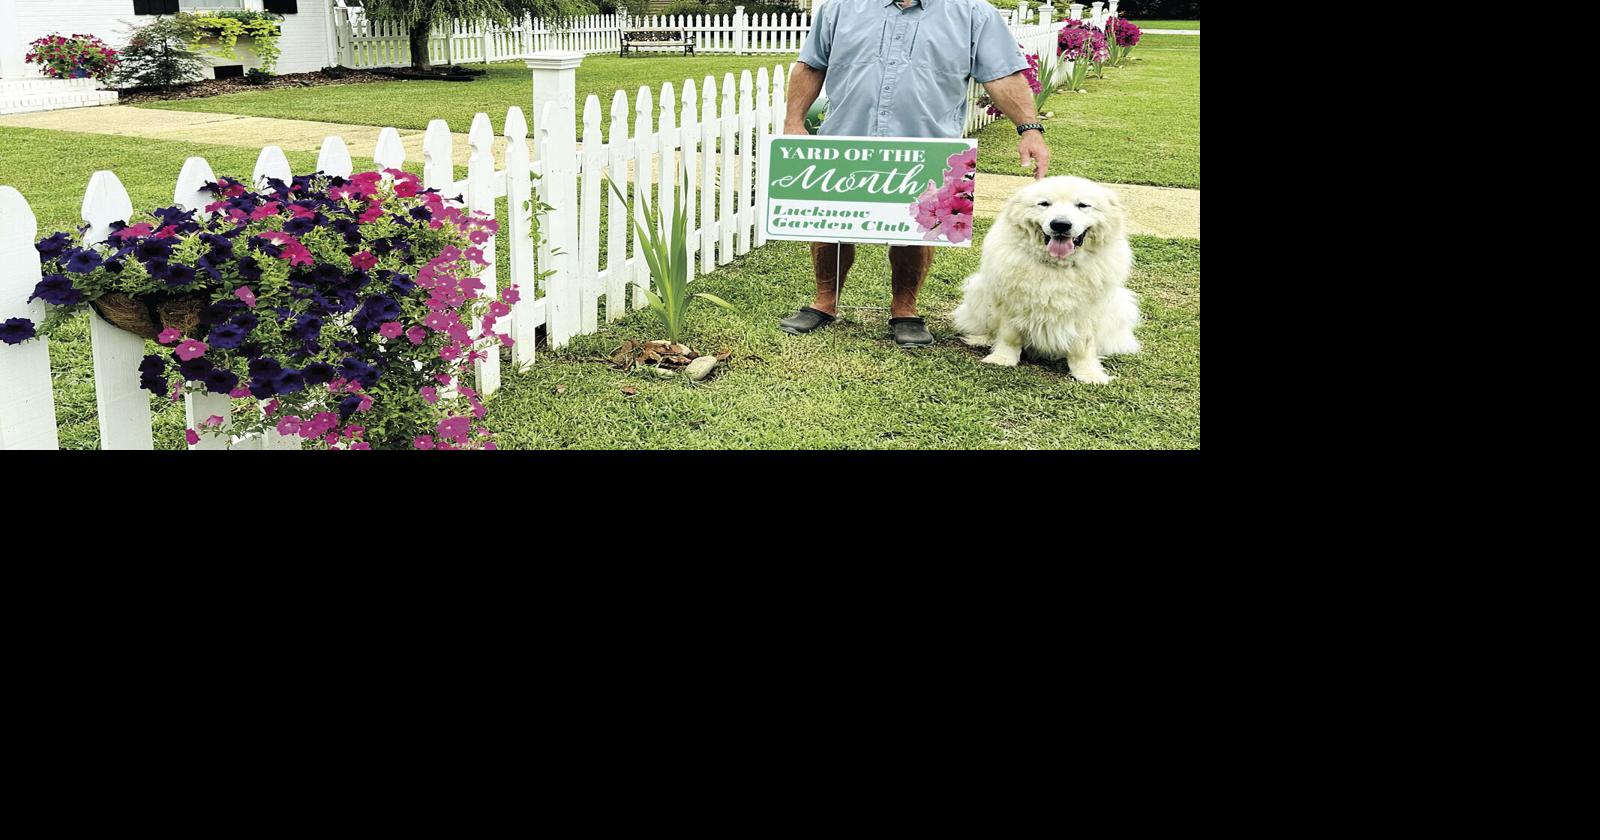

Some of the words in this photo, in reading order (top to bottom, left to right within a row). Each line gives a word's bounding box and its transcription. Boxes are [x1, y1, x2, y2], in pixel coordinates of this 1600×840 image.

[780, 147, 839, 160] YARD
[844, 148, 875, 161] OF
[880, 149, 926, 163] THE
[771, 164, 925, 195] Month
[773, 205, 870, 218] Lucknow
[772, 217, 853, 230] Garden
[860, 220, 910, 233] Club
